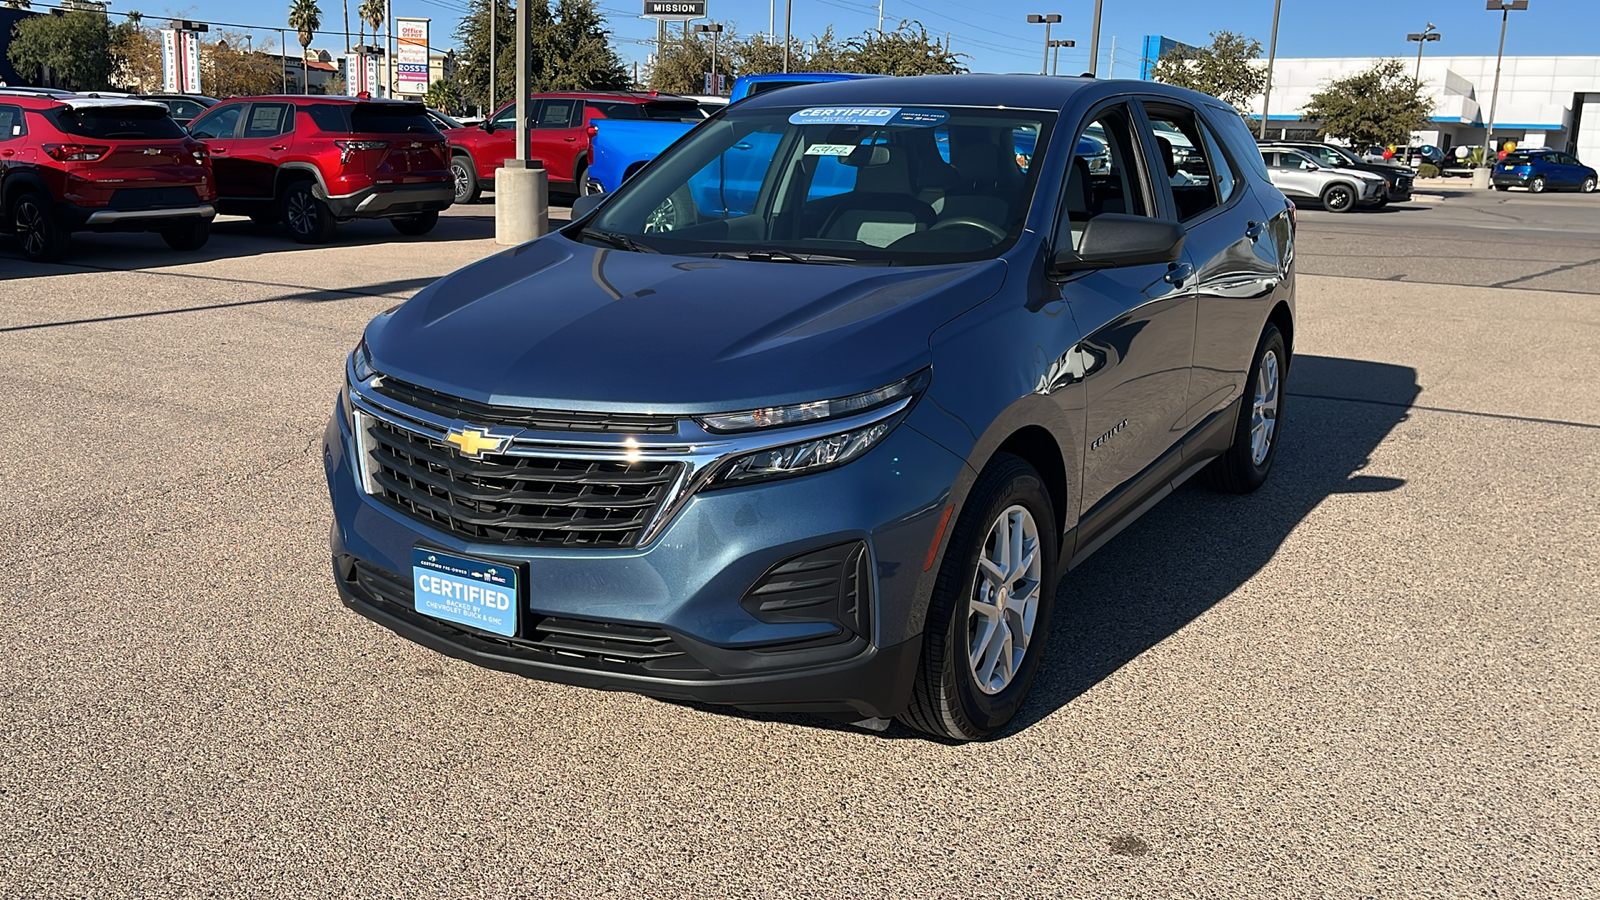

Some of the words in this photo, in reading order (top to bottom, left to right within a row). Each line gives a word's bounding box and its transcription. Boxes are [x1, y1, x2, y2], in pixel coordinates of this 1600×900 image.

[653, 4, 696, 12] MISSION
[166, 33, 175, 89] CERTIFIED
[398, 64, 420, 72] ROSS
[798, 109, 892, 117] CERTIFIED
[418, 574, 510, 611] CERTIFIED
[426, 600, 461, 614] CHEVROLET
[463, 609, 482, 620] BUICK
[488, 616, 502, 625] GMC
[446, 599, 471, 611] BACKED
[472, 605, 481, 613] BY
